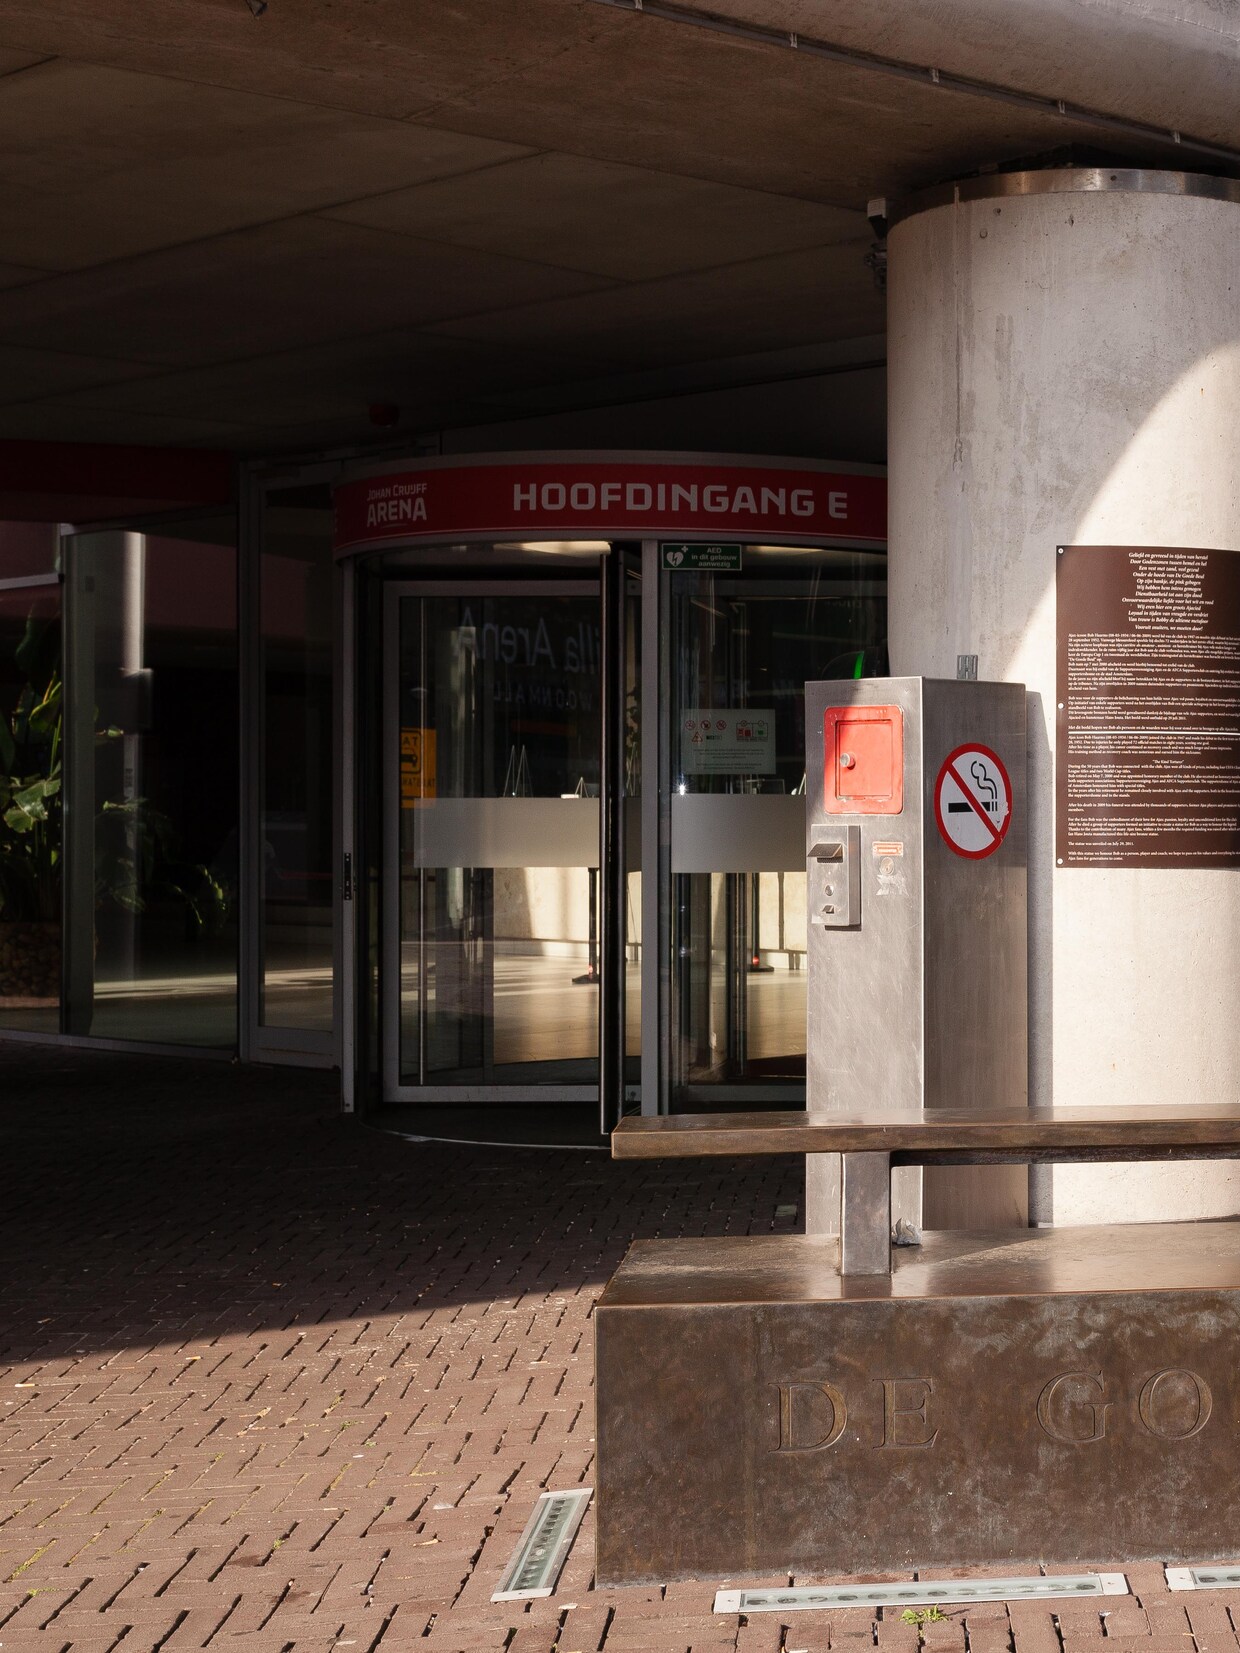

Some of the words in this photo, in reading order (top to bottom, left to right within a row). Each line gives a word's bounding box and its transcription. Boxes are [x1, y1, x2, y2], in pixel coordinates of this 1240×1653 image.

[366, 487, 391, 502] JOHAN
[513, 482, 815, 516] HOOFDINGANG
[828, 491, 848, 519] E
[366, 497, 428, 528] ARENA
[768, 1376, 939, 1454] DE
